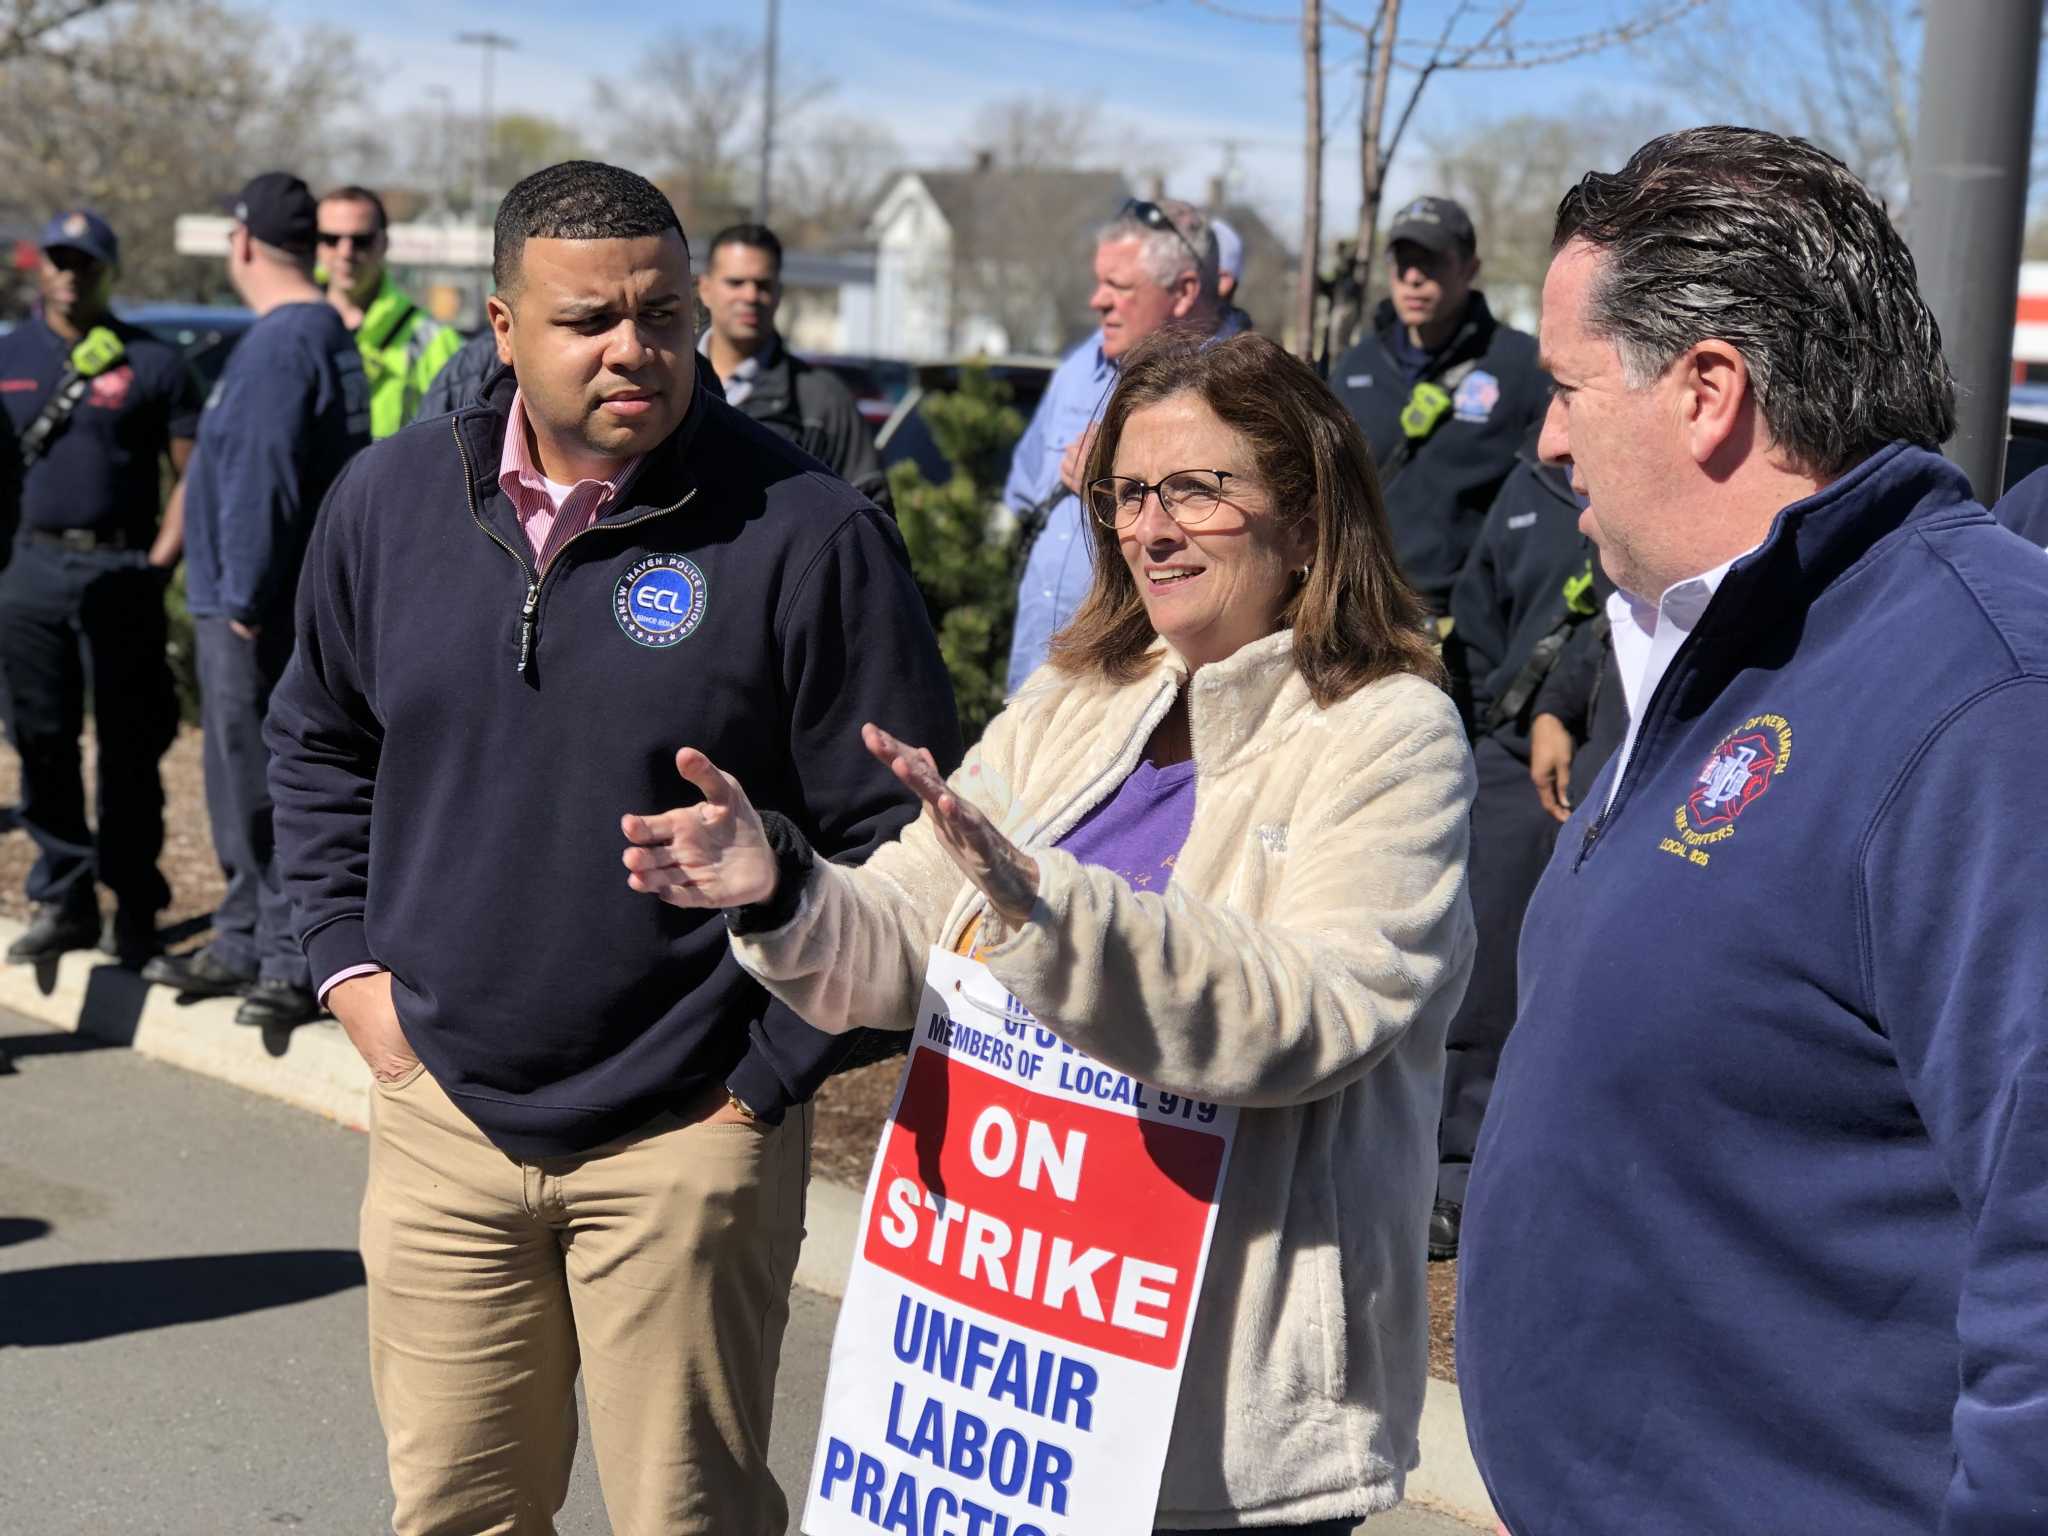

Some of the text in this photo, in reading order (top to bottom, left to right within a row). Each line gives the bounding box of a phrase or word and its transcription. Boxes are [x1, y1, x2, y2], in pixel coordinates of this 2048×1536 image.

[617, 557, 704, 629] NEW HAVEN POLICE UNION
[636, 585, 683, 614] ECL
[928, 1012, 1014, 1071] MEMBERS
[1018, 1049, 1044, 1081] OF
[1059, 1061, 1149, 1110] LOCAL
[969, 1105, 1088, 1202] ON
[879, 1177, 1179, 1339] STRIKE
[893, 1294, 1100, 1432] UNFAIR
[819, 1436, 1047, 1536] PRACT
[884, 1381, 1074, 1516] LABOR
